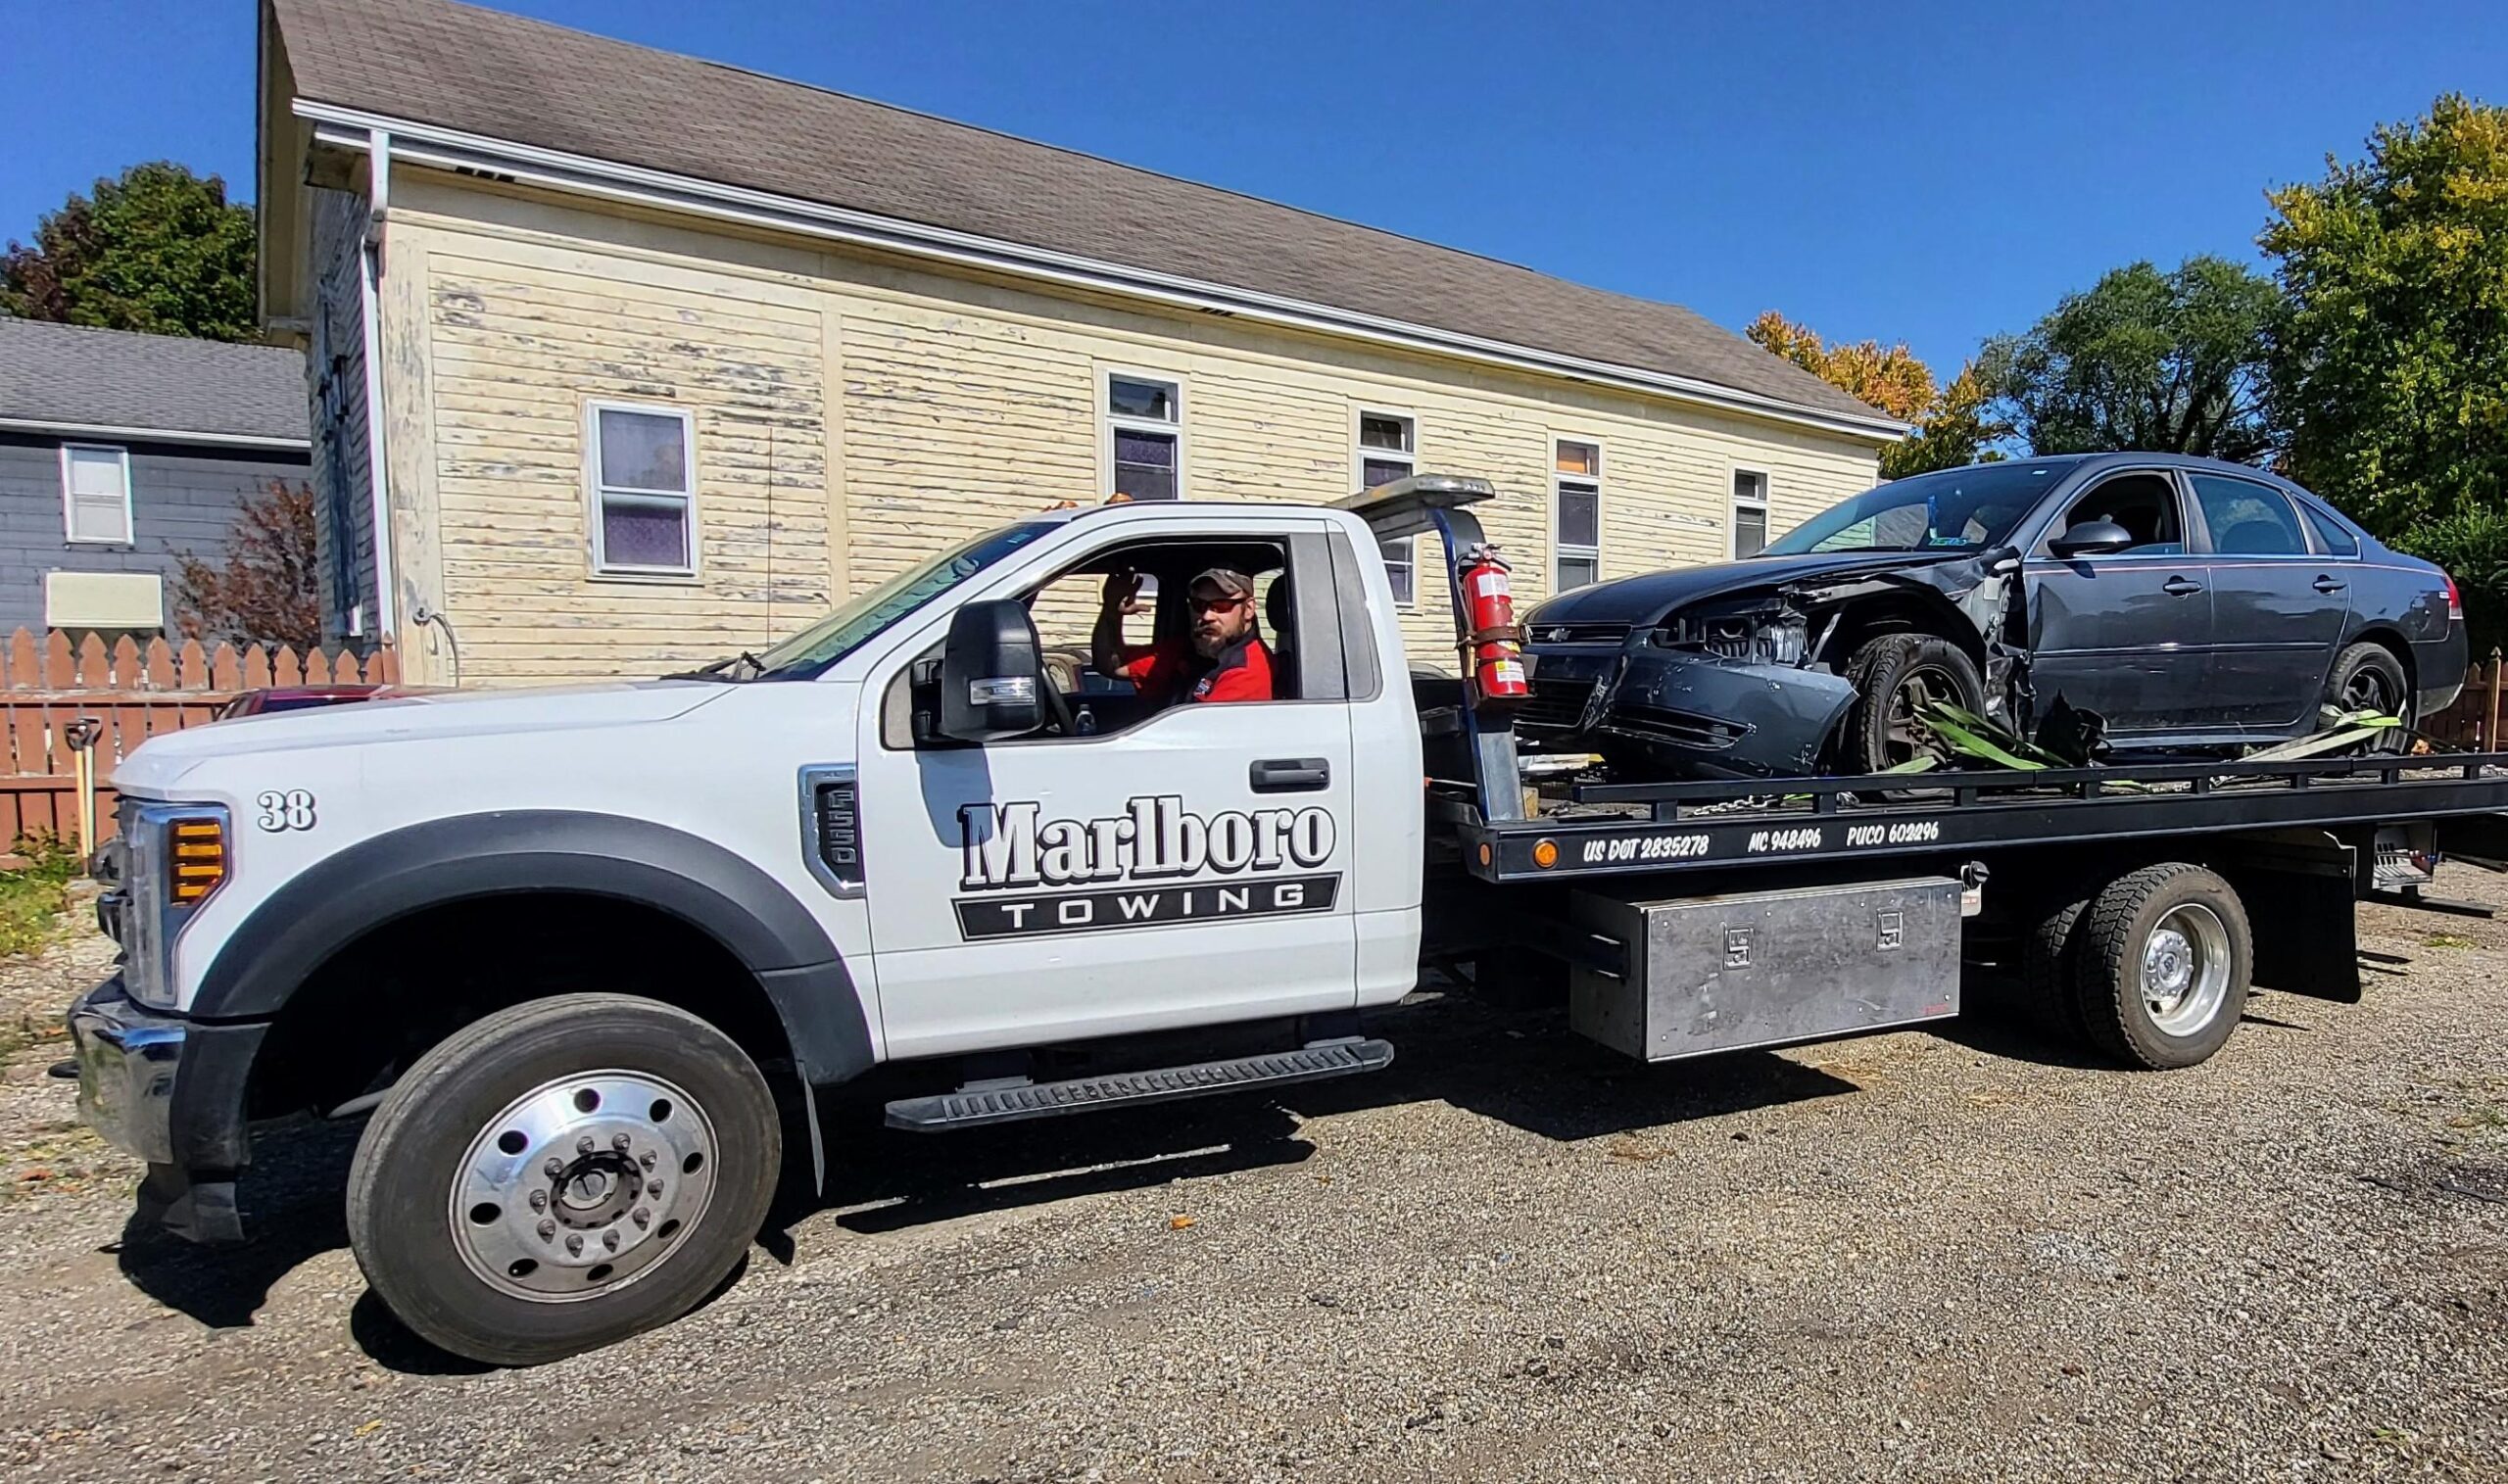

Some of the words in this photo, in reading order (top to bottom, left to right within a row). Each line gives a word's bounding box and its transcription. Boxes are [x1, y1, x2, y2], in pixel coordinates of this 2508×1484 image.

[257, 789, 317, 833] 38
[828, 790, 856, 864] F550
[958, 794, 1336, 891] Marlboro
[1583, 839, 1606, 862] US
[1608, 838, 1641, 861] DOT
[1640, 835, 1710, 859] 2835278
[1748, 832, 1768, 853] MC
[1771, 828, 1821, 850] 948496
[1846, 825, 1885, 846] PUCO
[1888, 821, 1939, 843] 602296
[1000, 884, 1305, 930] TOWING
